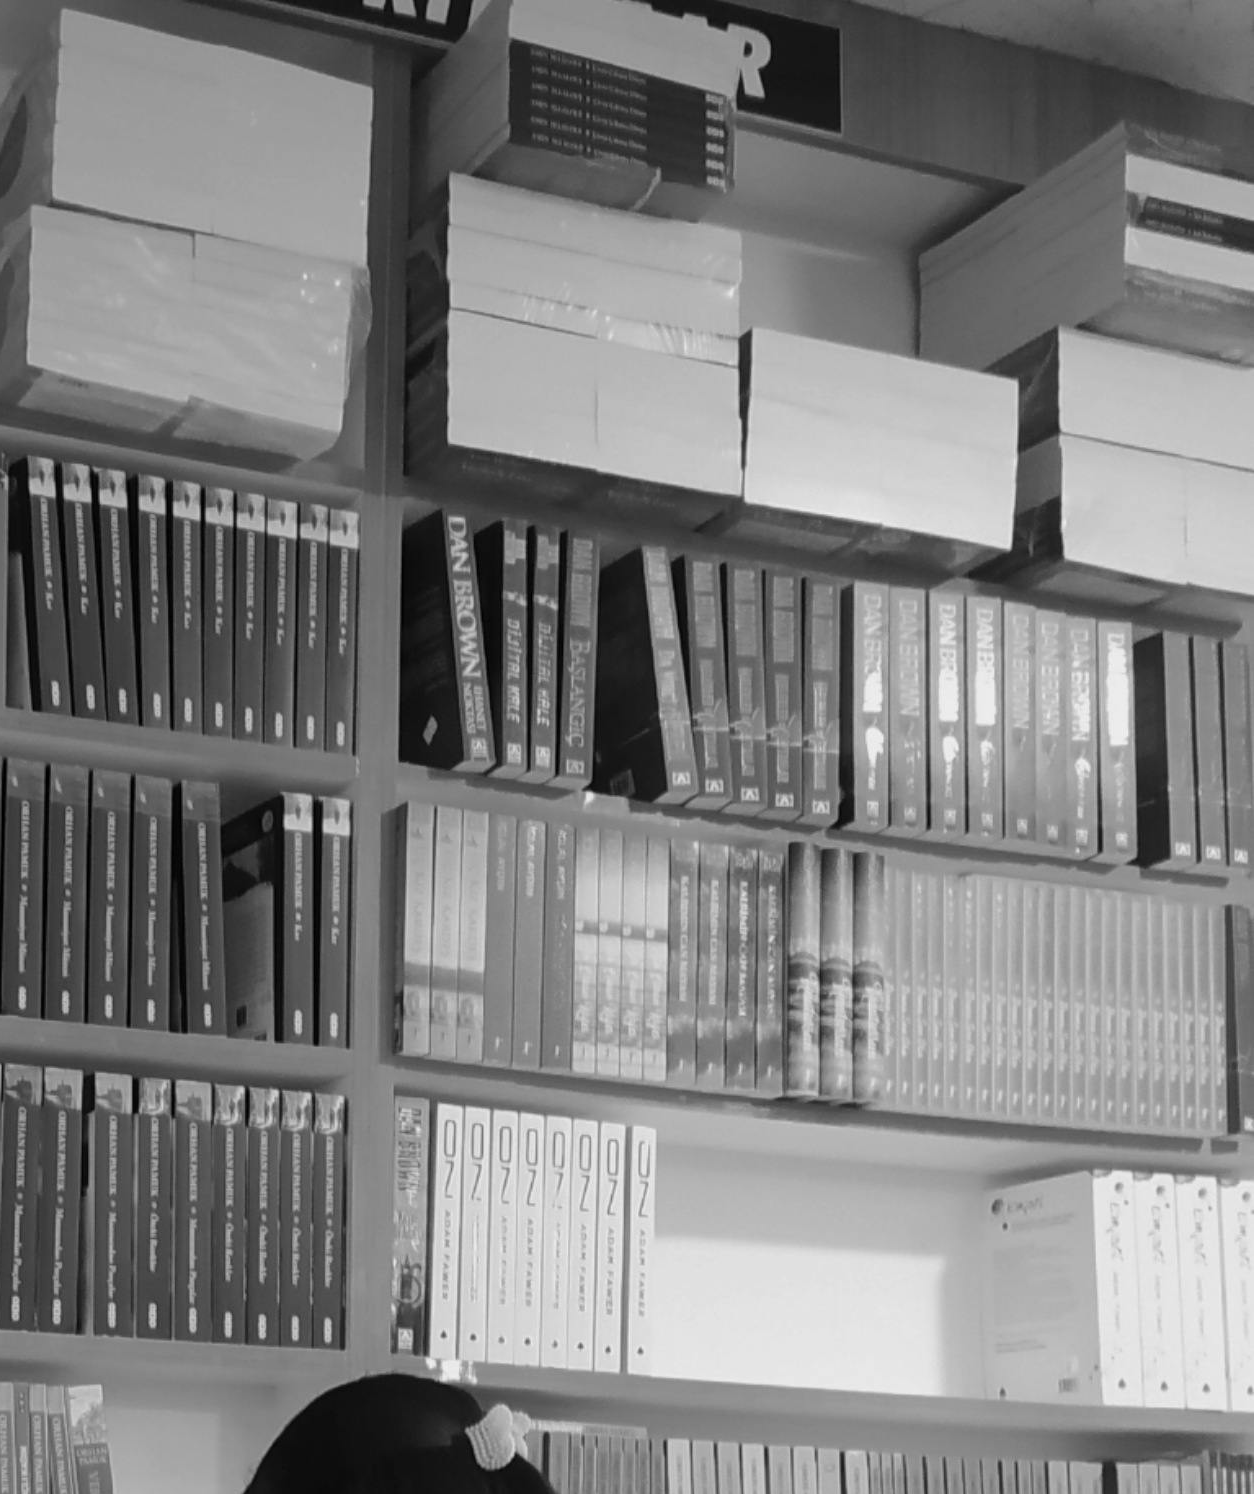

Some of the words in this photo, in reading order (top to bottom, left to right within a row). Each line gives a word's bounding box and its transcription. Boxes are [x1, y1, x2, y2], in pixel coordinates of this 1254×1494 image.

[447, 515, 470, 572] DAN
[453, 580, 481, 677] BROWN
[863, 594, 881, 635] DAN
[898, 599, 917, 641] DAN
[938, 604, 956, 645] DAN
[975, 608, 993, 650] DAN
[1040, 621, 1058, 662] DAN
[506, 684, 520, 723] KALE
[536, 689, 550, 726] KALE
